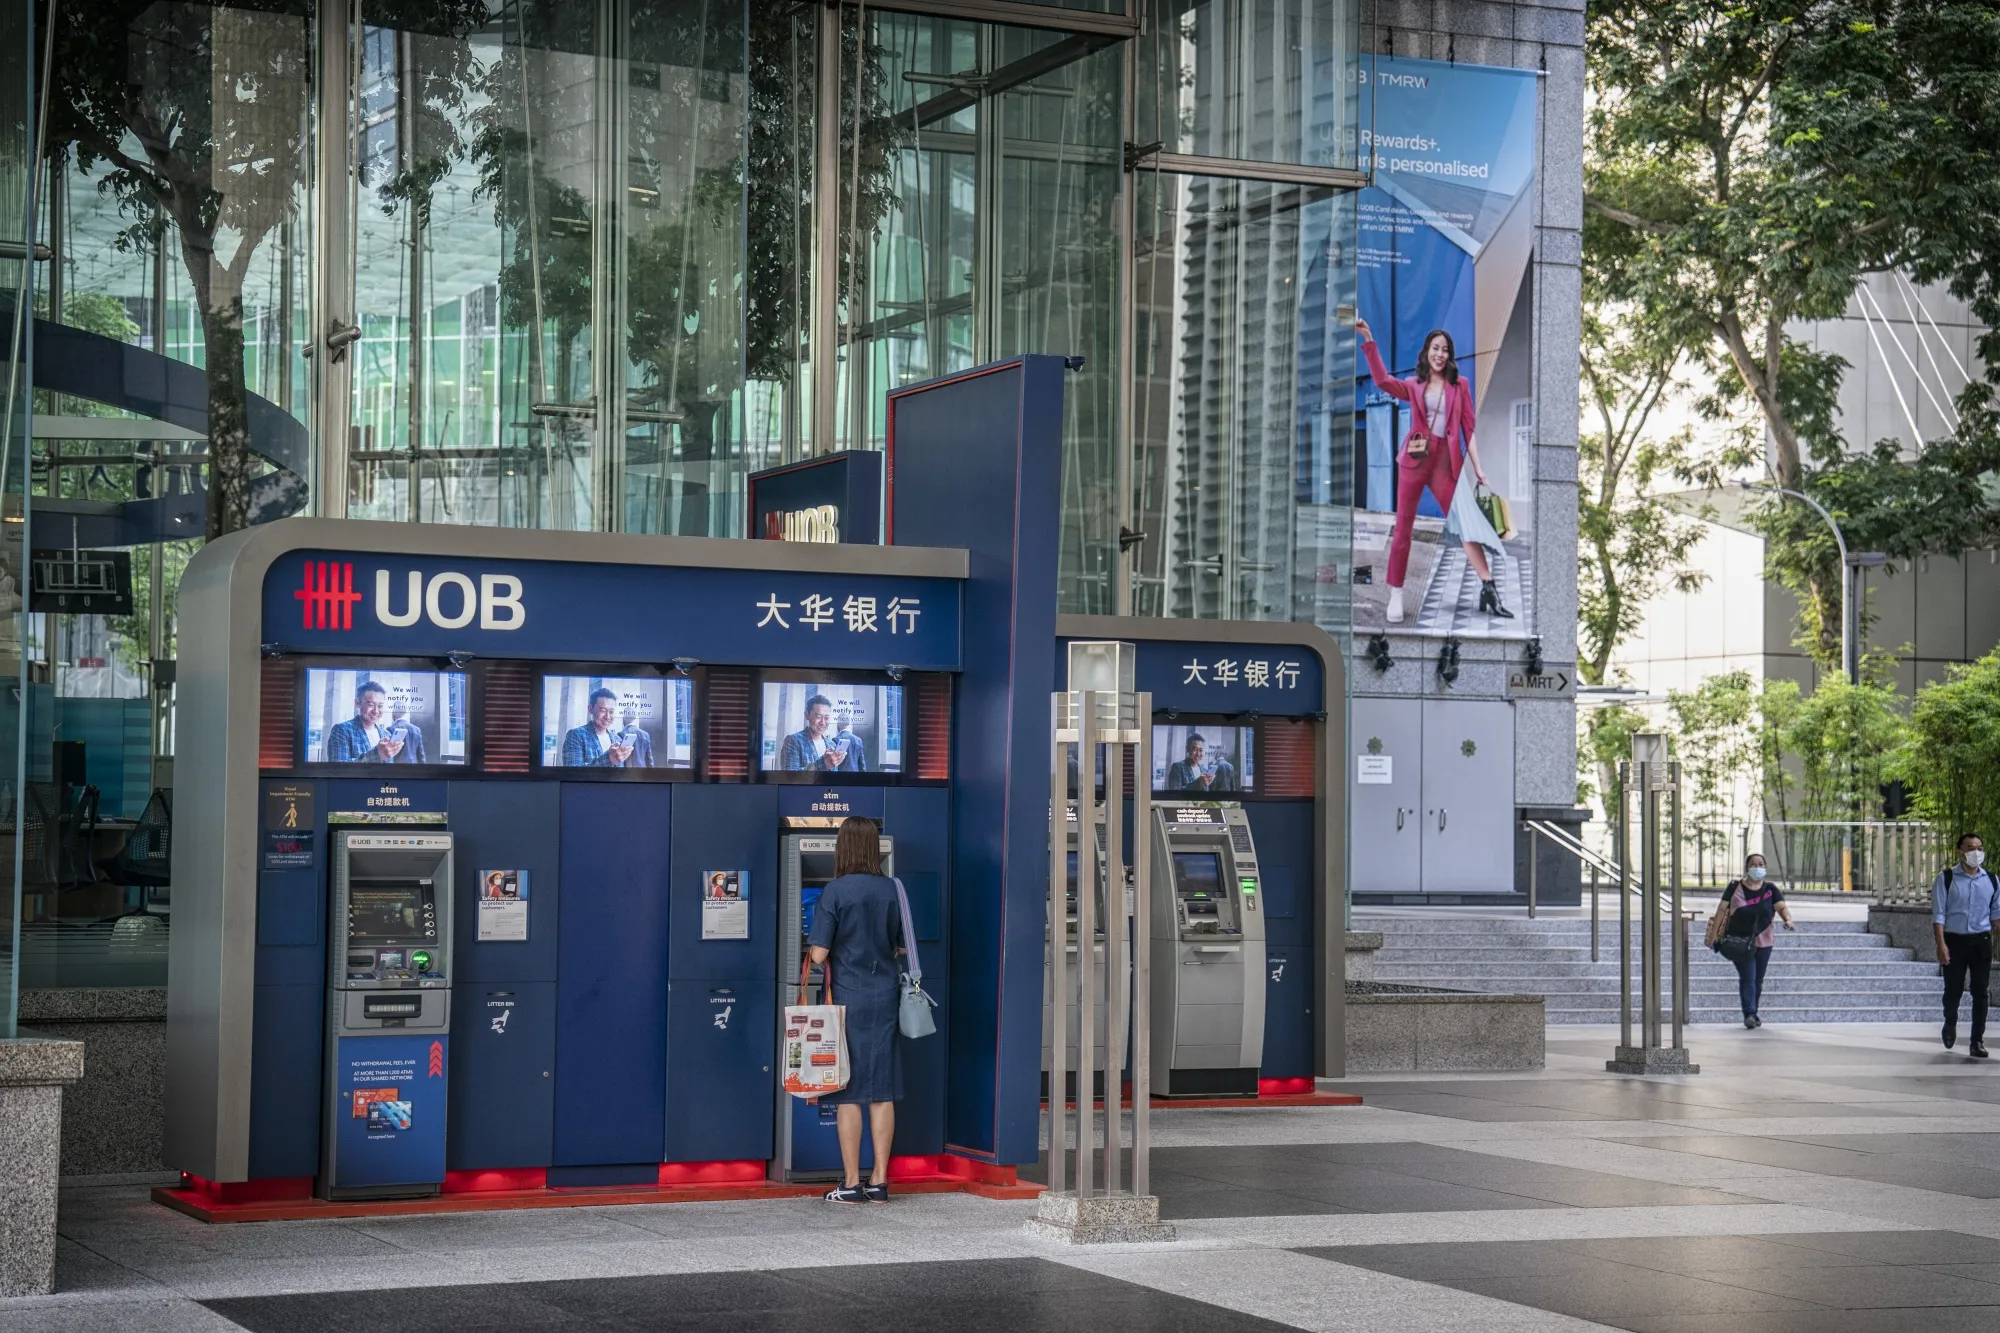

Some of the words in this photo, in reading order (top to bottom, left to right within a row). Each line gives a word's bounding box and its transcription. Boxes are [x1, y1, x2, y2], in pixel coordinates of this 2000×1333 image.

[1379, 73, 1429, 89] TMRW
[1361, 130, 1440, 152] Rewards+.
[1391, 156, 1489, 178] personalised
[376, 569, 526, 630] UOB
[756, 592, 921, 634] 大华银行
[1182, 658, 1300, 689] 大华银行
[1526, 677, 1554, 689] MRT
[380, 786, 398, 794] atm
[367, 797, 410, 806] 自动提款机
[812, 803, 850, 812] 自动提款机
